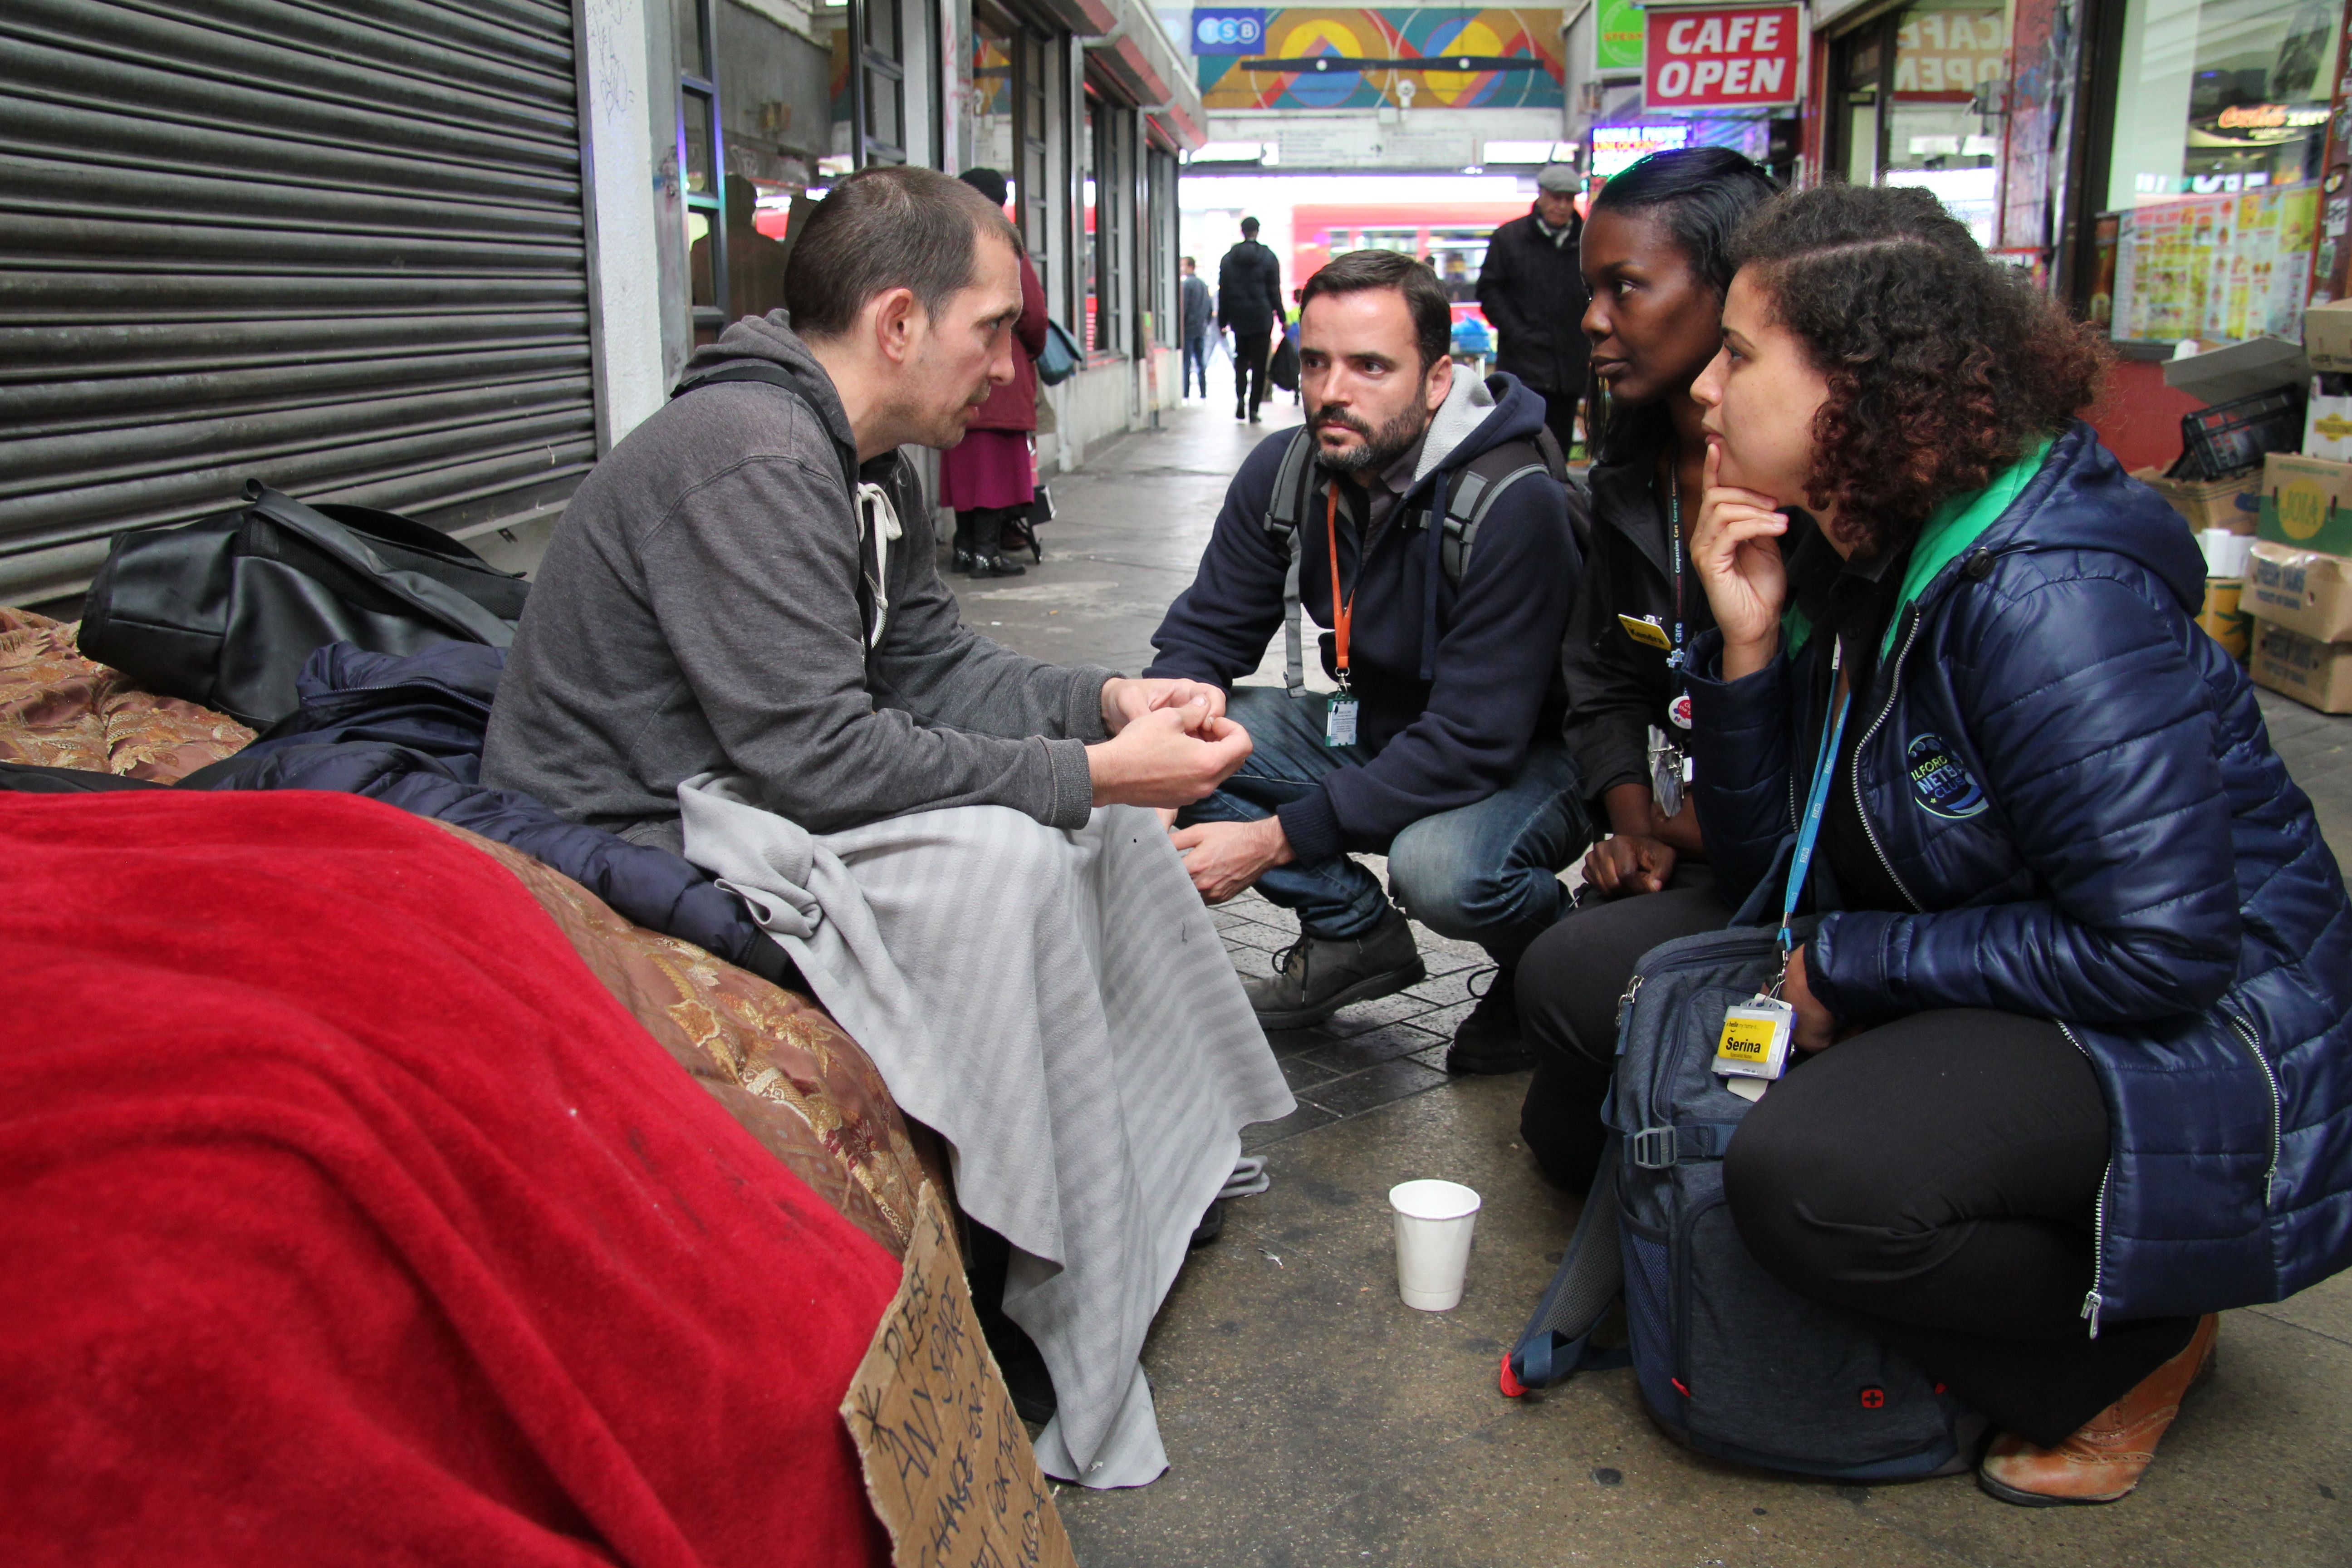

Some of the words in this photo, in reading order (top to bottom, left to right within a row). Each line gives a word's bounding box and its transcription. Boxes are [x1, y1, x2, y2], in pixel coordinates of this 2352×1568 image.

[1202, 21, 1257, 41] TSB
[1666, 15, 1782, 54] CAFE
[1656, 58, 1785, 98] OPEN
[1911, 755, 1948, 781] ILFORD
[1800, 847, 1810, 863] NHS
[1725, 1037, 1761, 1054] Serina
[888, 1371, 944, 1521] ANY
[930, 1274, 965, 1403] SPARE
[997, 1396, 1021, 1482] THE
